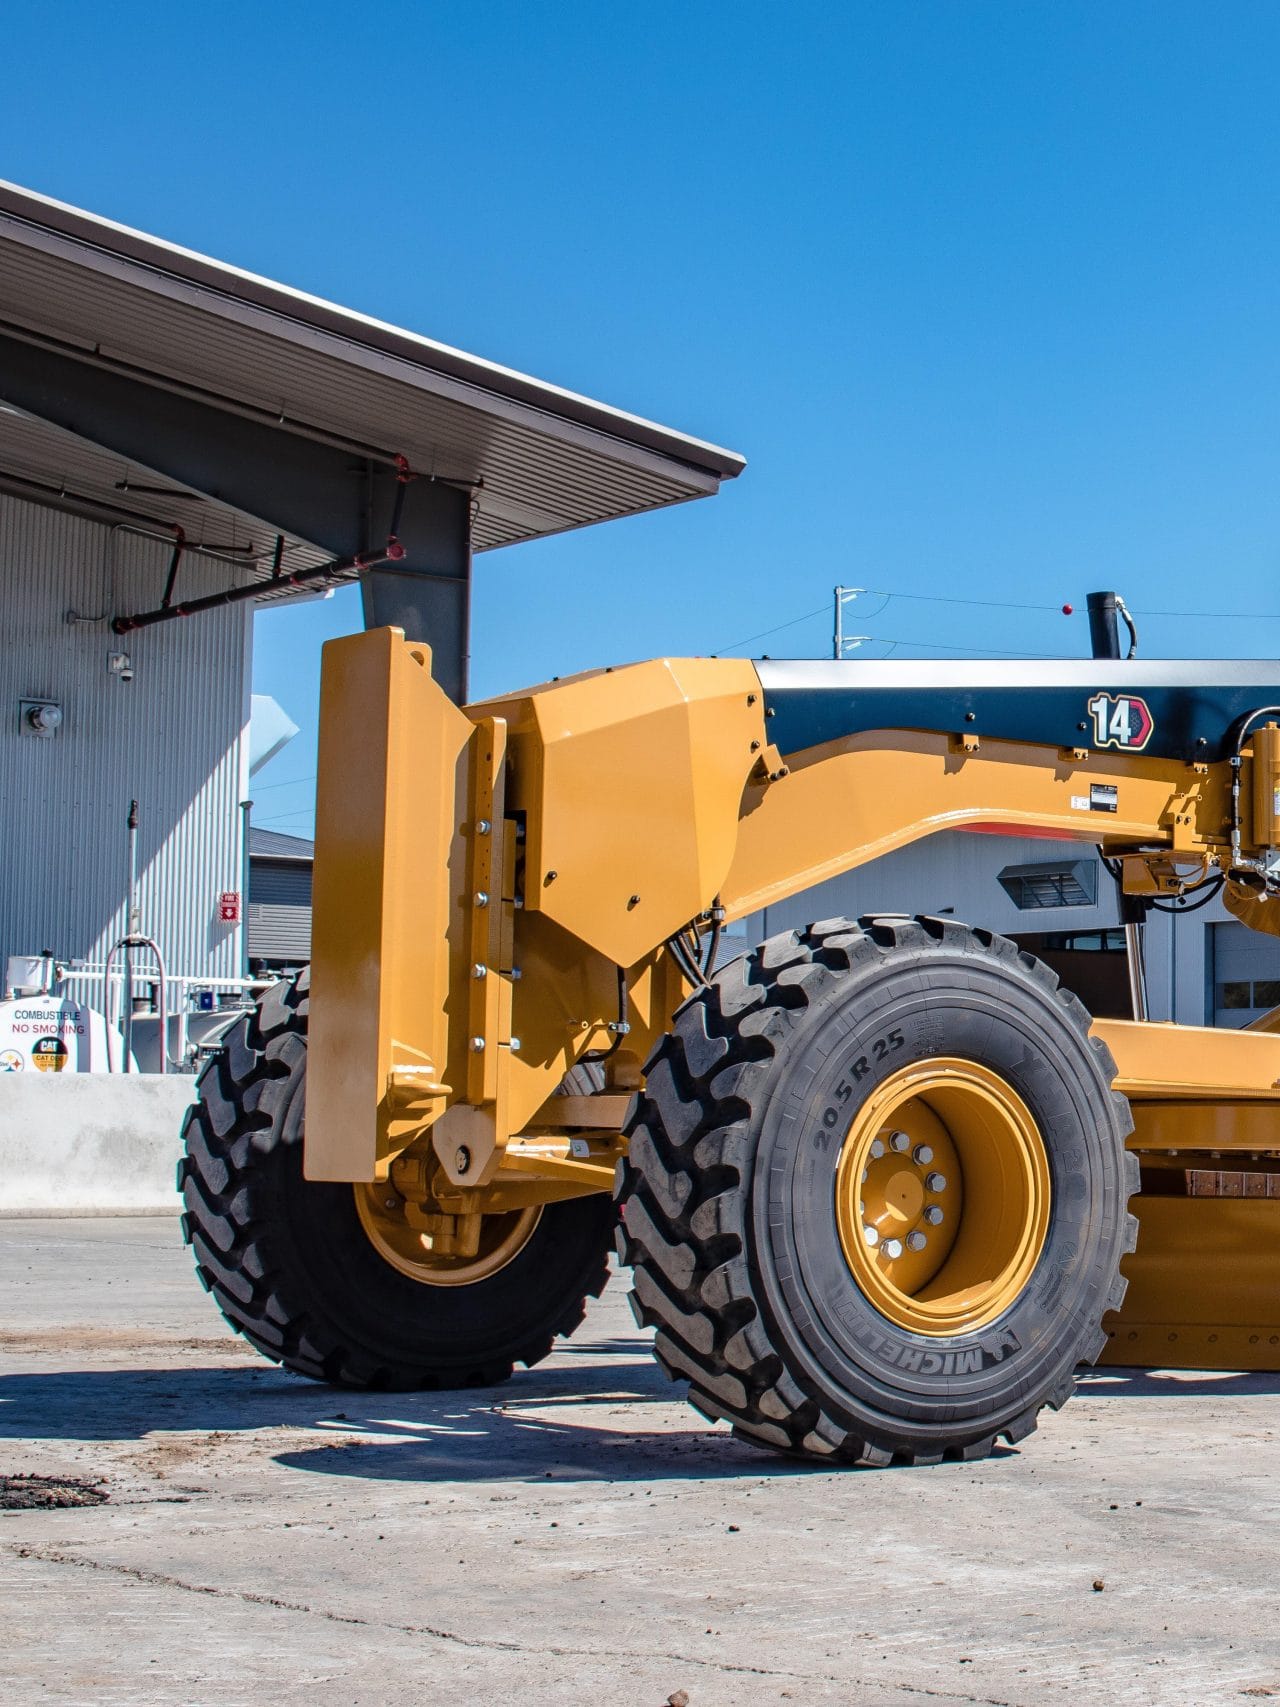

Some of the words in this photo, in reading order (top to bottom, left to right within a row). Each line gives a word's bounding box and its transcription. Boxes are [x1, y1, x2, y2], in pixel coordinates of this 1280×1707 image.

[1091, 697, 1131, 744] 14
[12, 1025, 29, 1033] NO
[33, 1025, 85, 1034] SMOKING
[14, 1010, 81, 1020] COMBUSTIBLE
[41, 1041, 58, 1052] CAT
[812, 1080, 853, 1153] 20.5
[849, 1055, 872, 1082] R
[872, 1028, 905, 1061] 25
[832, 1302, 983, 1375] MICHELIN
